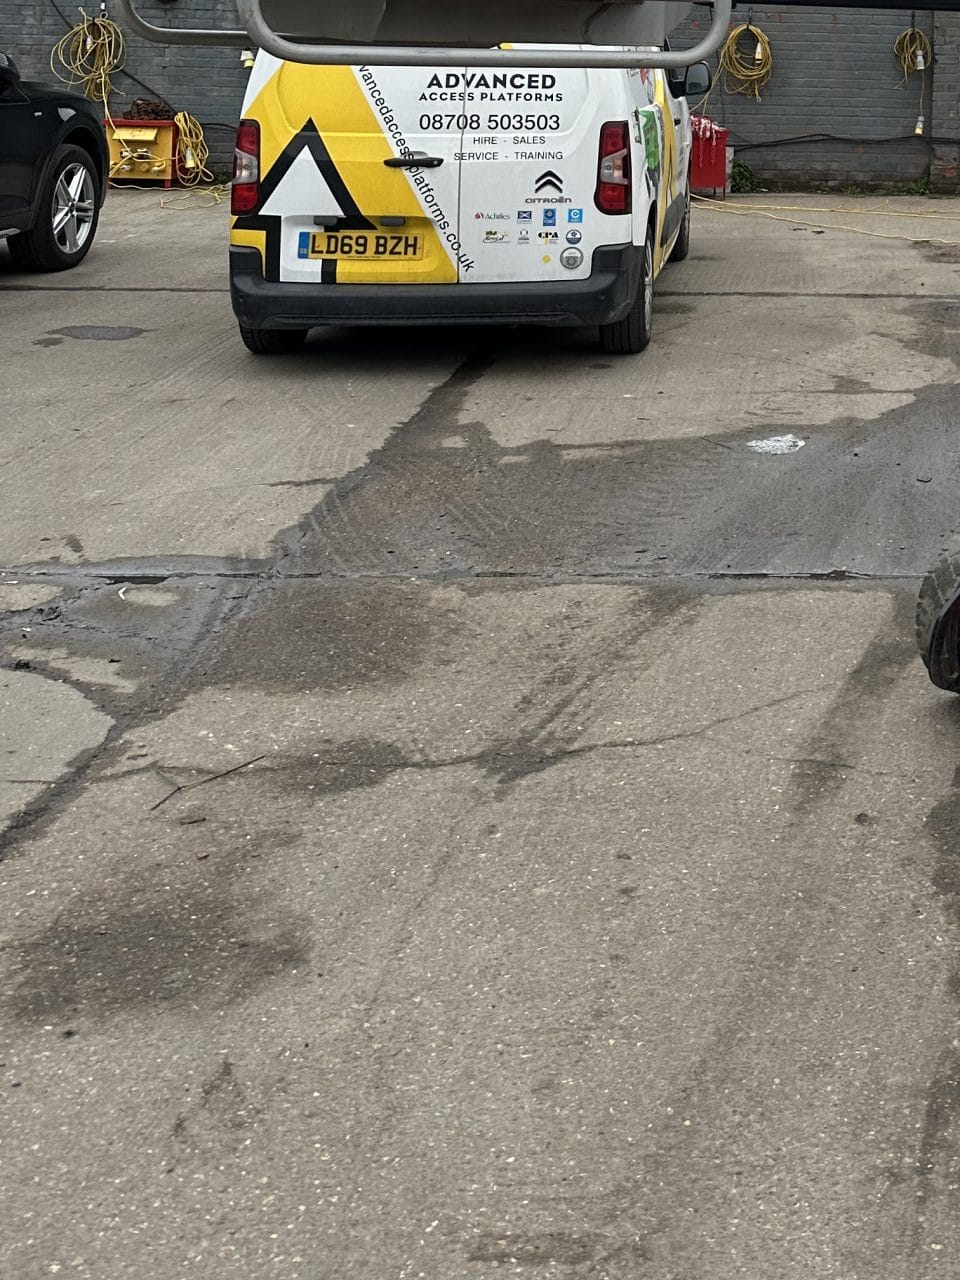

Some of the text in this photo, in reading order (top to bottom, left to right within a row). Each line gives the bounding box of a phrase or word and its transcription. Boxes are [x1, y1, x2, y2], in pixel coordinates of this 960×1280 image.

[427, 73, 556, 89] ADVANCED
[419, 92, 563, 102] ACCESS PLATFORMS
[419, 113, 560, 130] 08708 503503
[473, 136, 498, 145] HIRE
[513, 136, 546, 145] SALES
[454, 152, 499, 161] SERVICE
[515, 151, 564, 161] TRAINING
[538, 231, 559, 239] CPA
[311, 234, 418, 255] LD69 BZH
